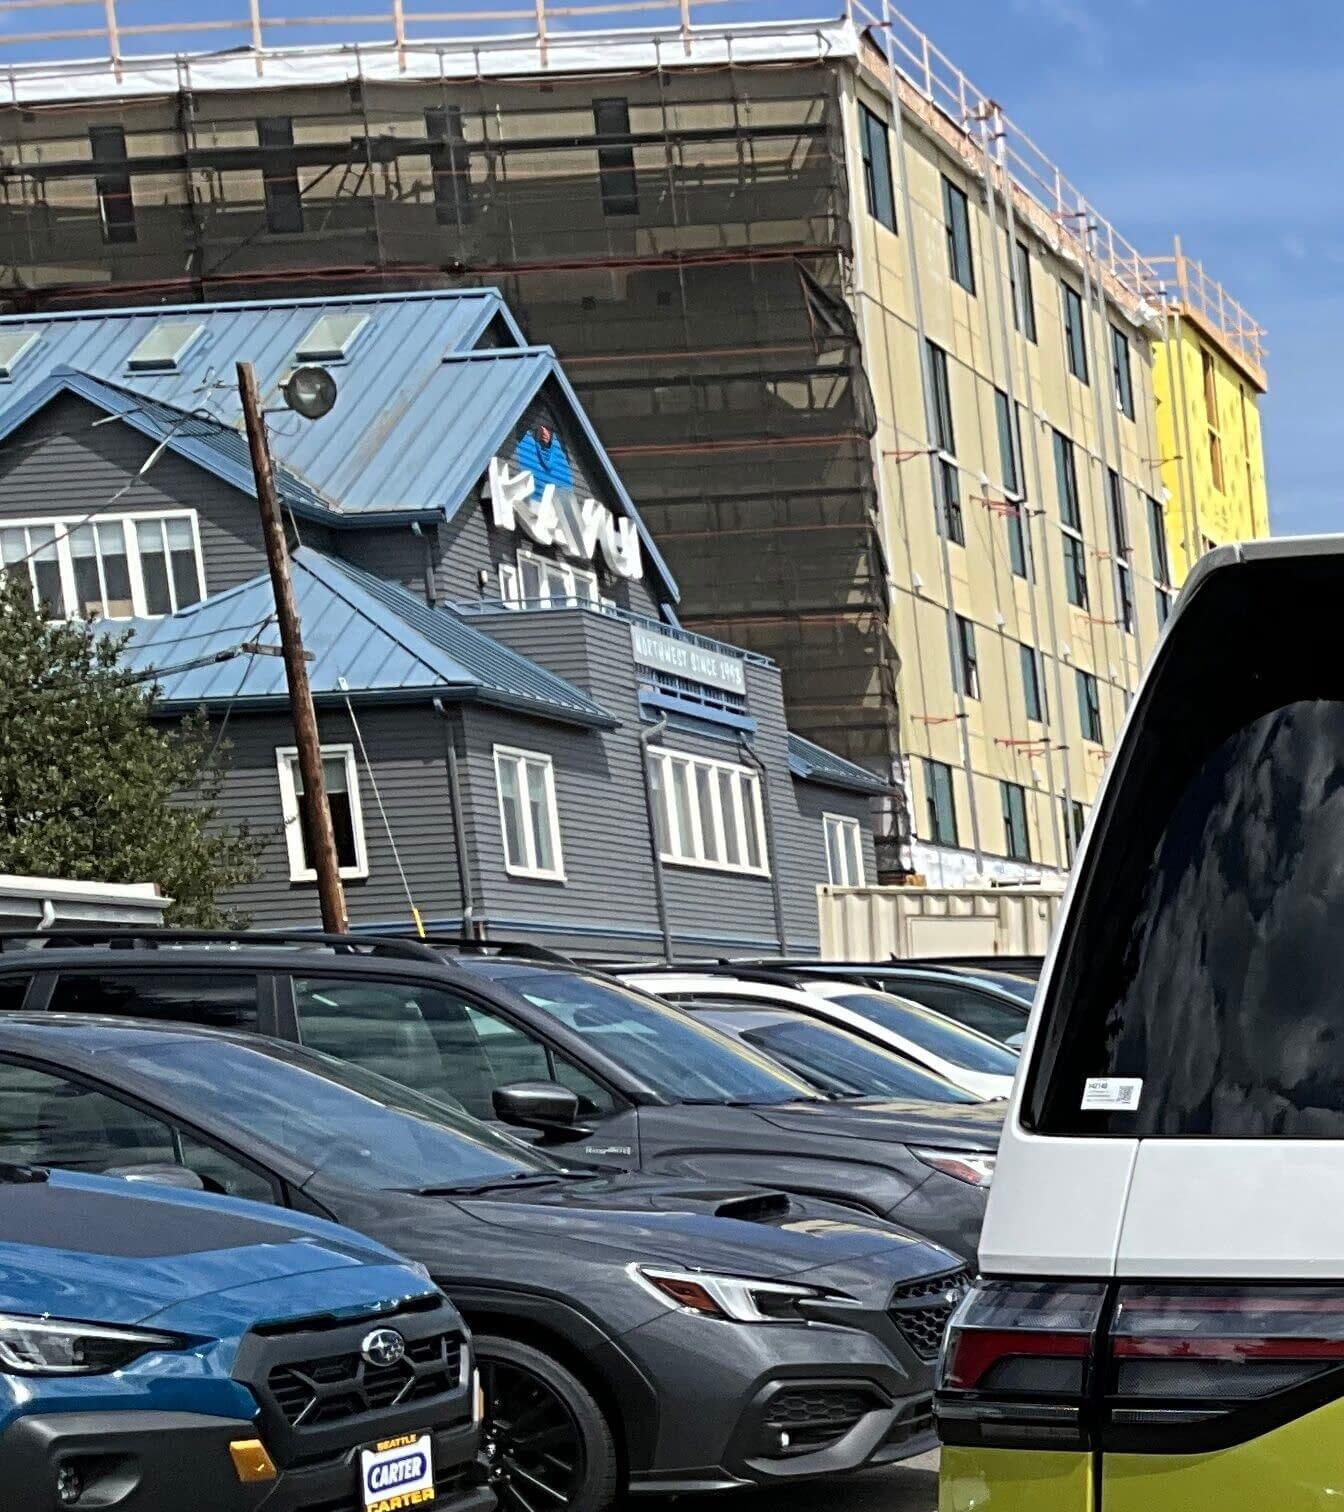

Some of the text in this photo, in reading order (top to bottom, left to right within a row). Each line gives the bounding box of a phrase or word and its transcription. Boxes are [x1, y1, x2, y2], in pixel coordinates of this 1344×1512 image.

[487, 456, 643, 580] KAVU
[377, 1433, 417, 1451] SEATTLE
[371, 1456, 422, 1489] CARTER
